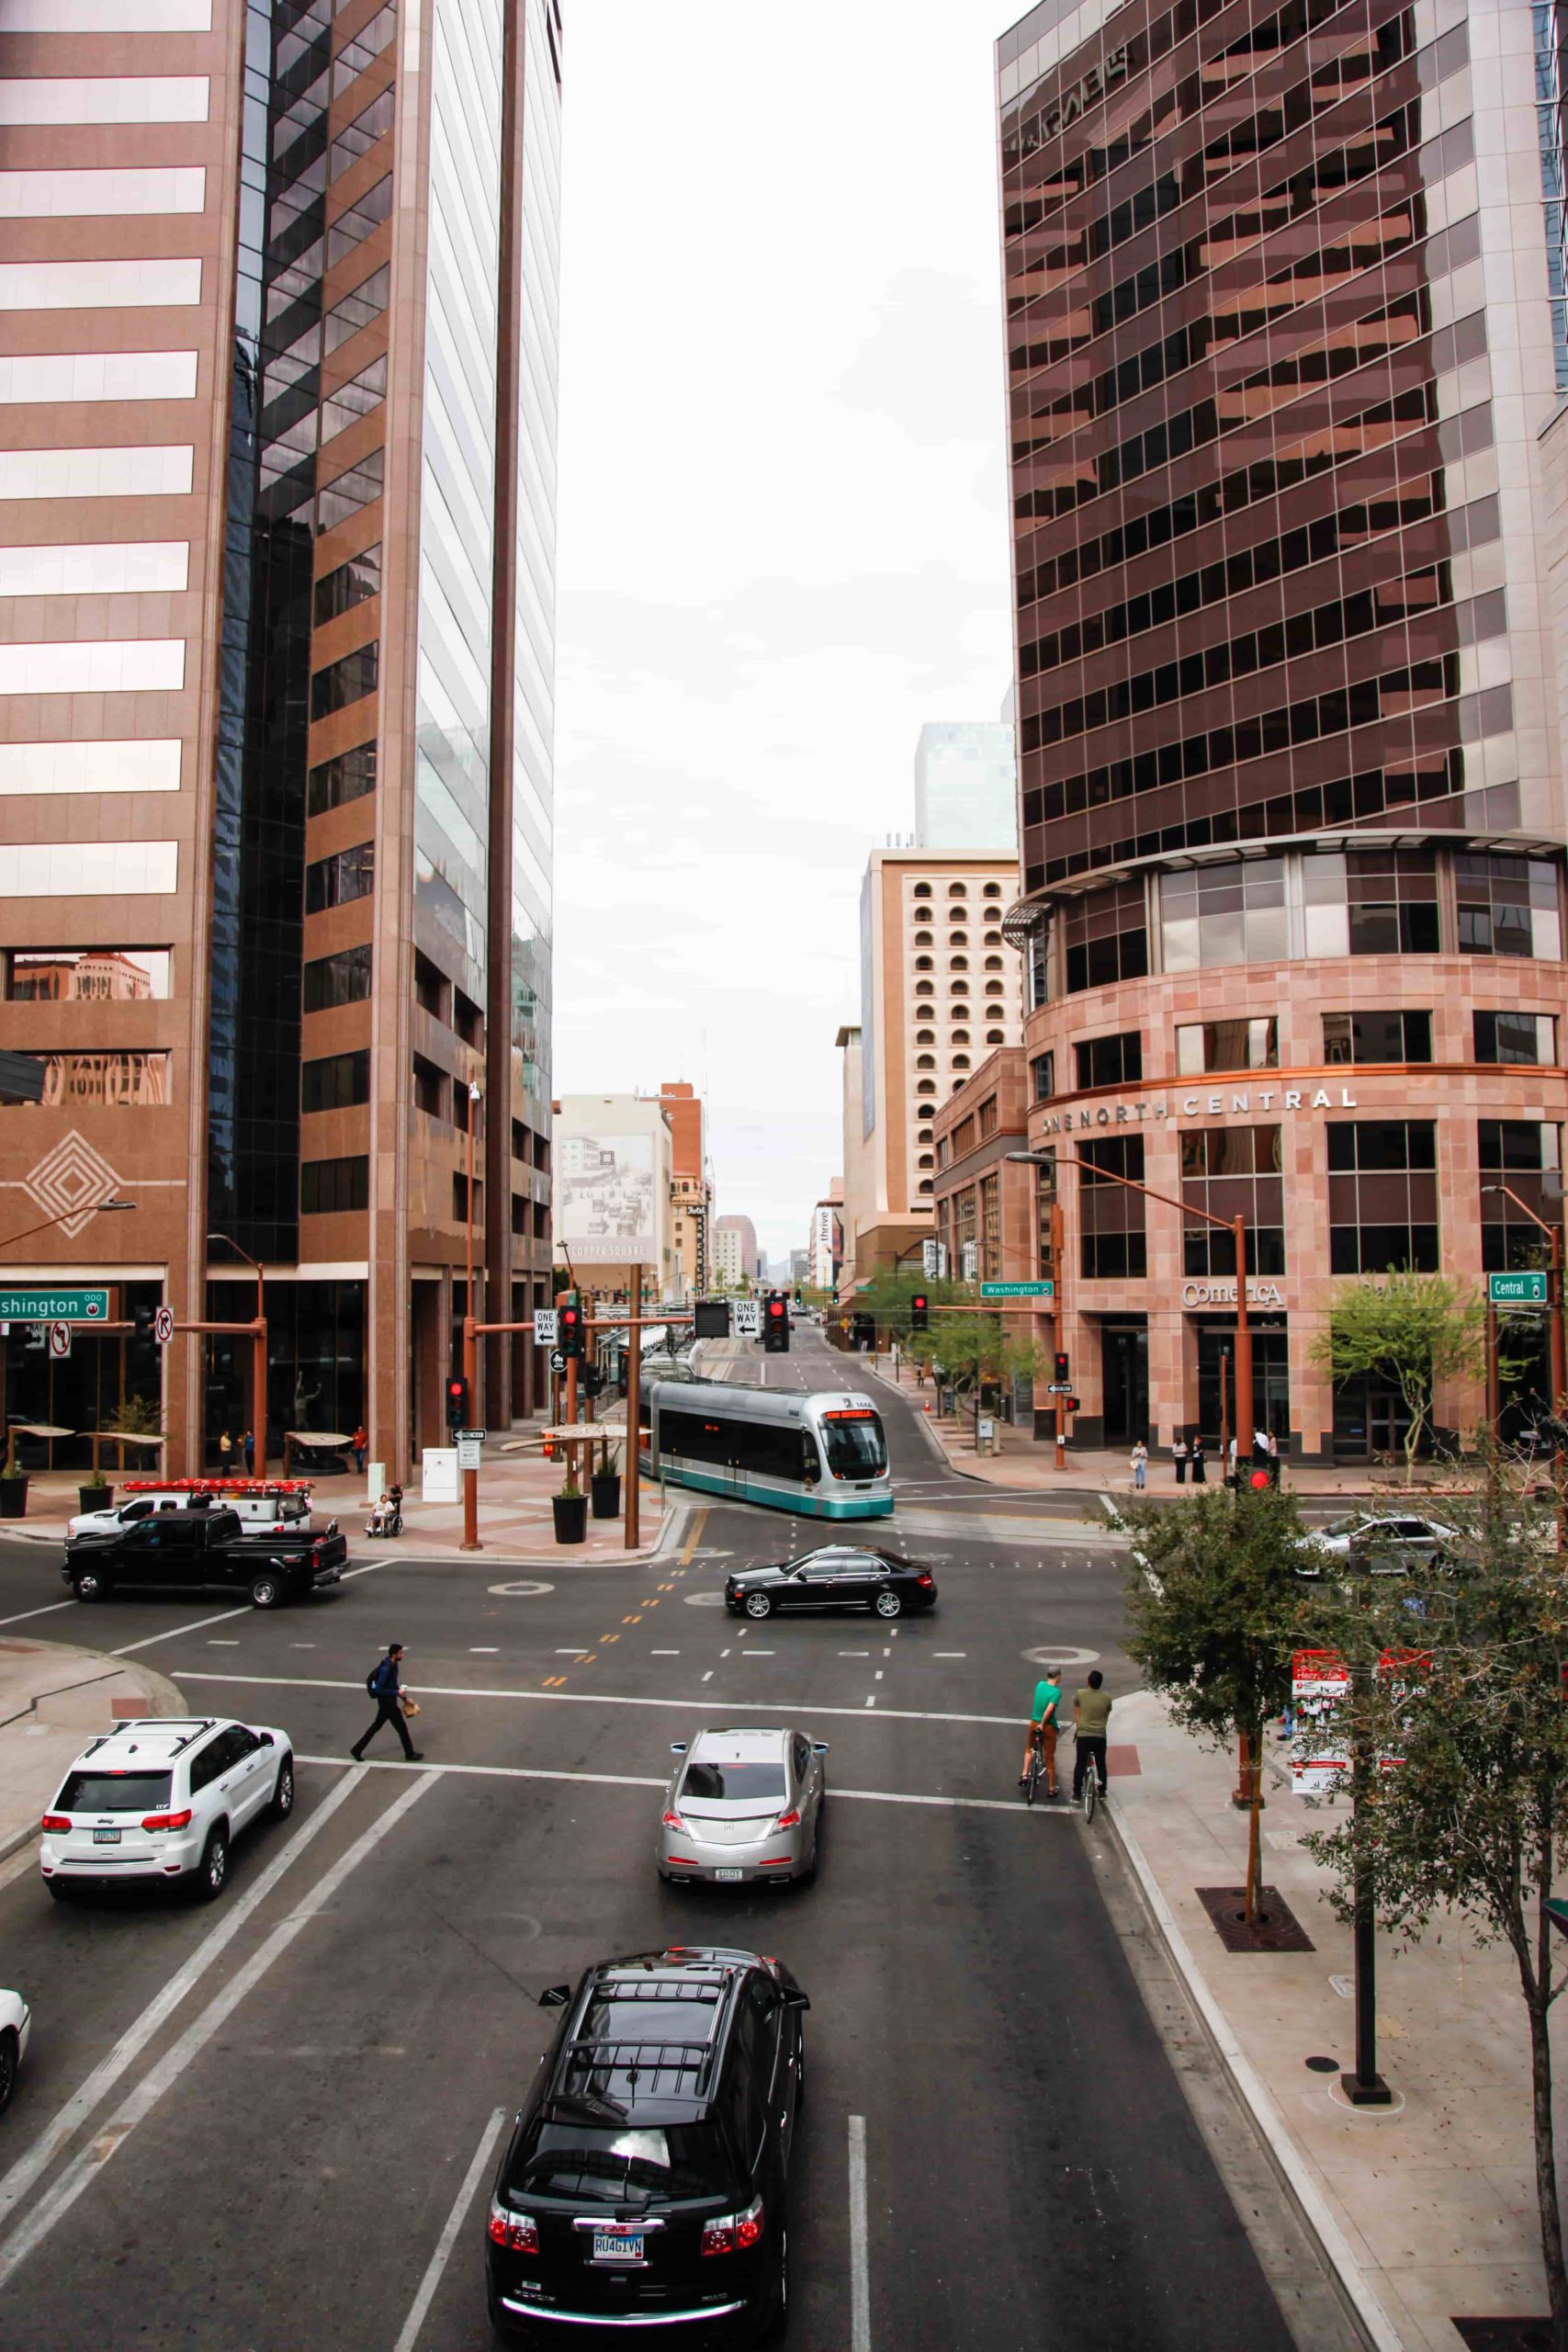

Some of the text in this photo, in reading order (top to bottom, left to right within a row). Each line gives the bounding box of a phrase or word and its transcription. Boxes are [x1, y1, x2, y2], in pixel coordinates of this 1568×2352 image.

[1043, 1088, 1357, 1135] ONE NORTH CENTRAL
[820, 1212, 829, 1240] thrive
[571, 1244, 645, 1257] COPPER SQUARE
[987, 1286, 1039, 1295] Washington
[1495, 1281, 1524, 1295] Central
[738, 1303, 756, 1313] ONE
[537, 1312, 554, 1321] ONE
[737, 1314, 757, 1323] WAY
[536, 1323, 554, 1331] WAY
[595, 2238, 642, 2253] RU4GIVN
